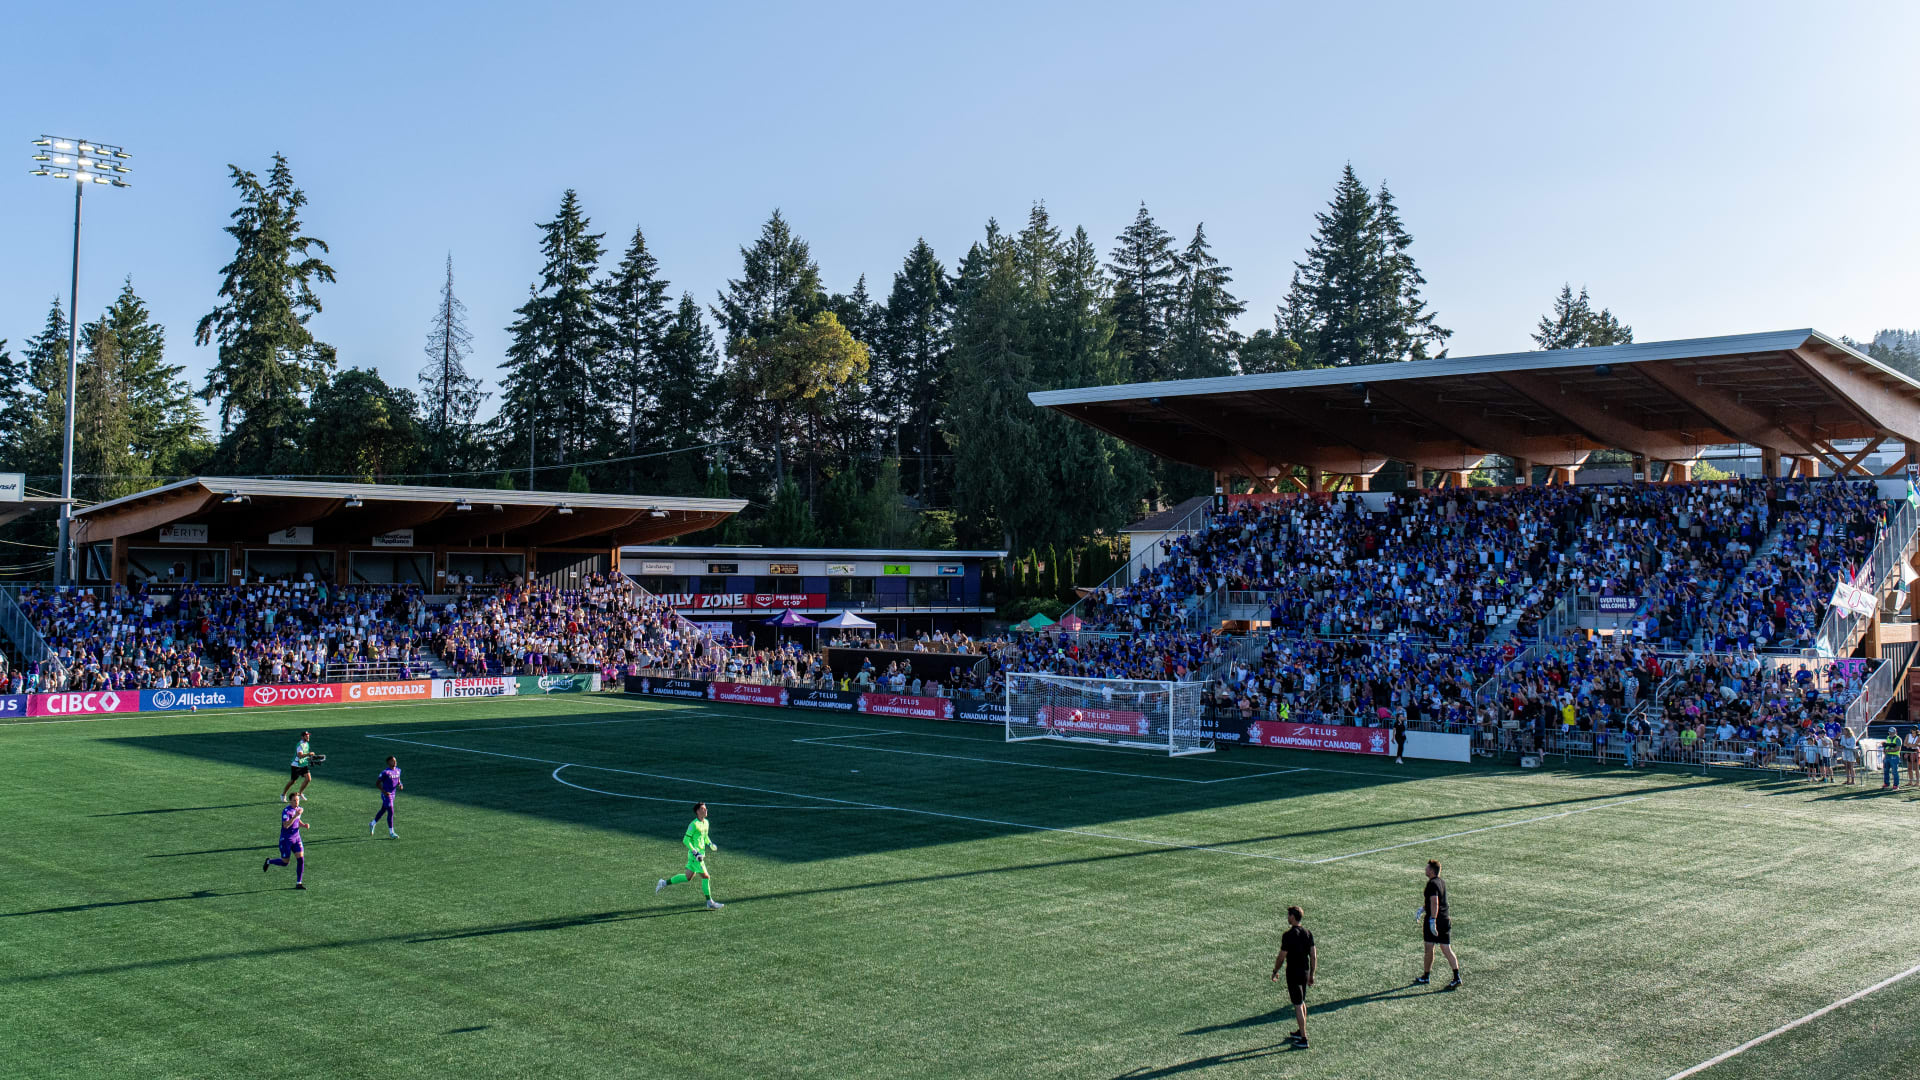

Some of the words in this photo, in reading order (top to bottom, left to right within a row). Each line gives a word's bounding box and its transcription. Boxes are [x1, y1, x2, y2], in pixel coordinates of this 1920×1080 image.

[701, 594, 744, 608] ZONE
[455, 677, 504, 687] SENTINEL
[538, 675, 574, 691] Carlsberg
[280, 687, 334, 700] TOYOTA
[367, 685, 425, 696] GATORADE
[454, 686, 504, 697] STORAGE
[46, 693, 97, 713] CIBC
[176, 692, 226, 706] Allstate
[1087, 711, 1111, 719] TELUS
[1309, 727, 1338, 737] TELUS
[1270, 735, 1322, 748] CHAMPIONNAT
[1324, 740, 1362, 751] CANADIEN
